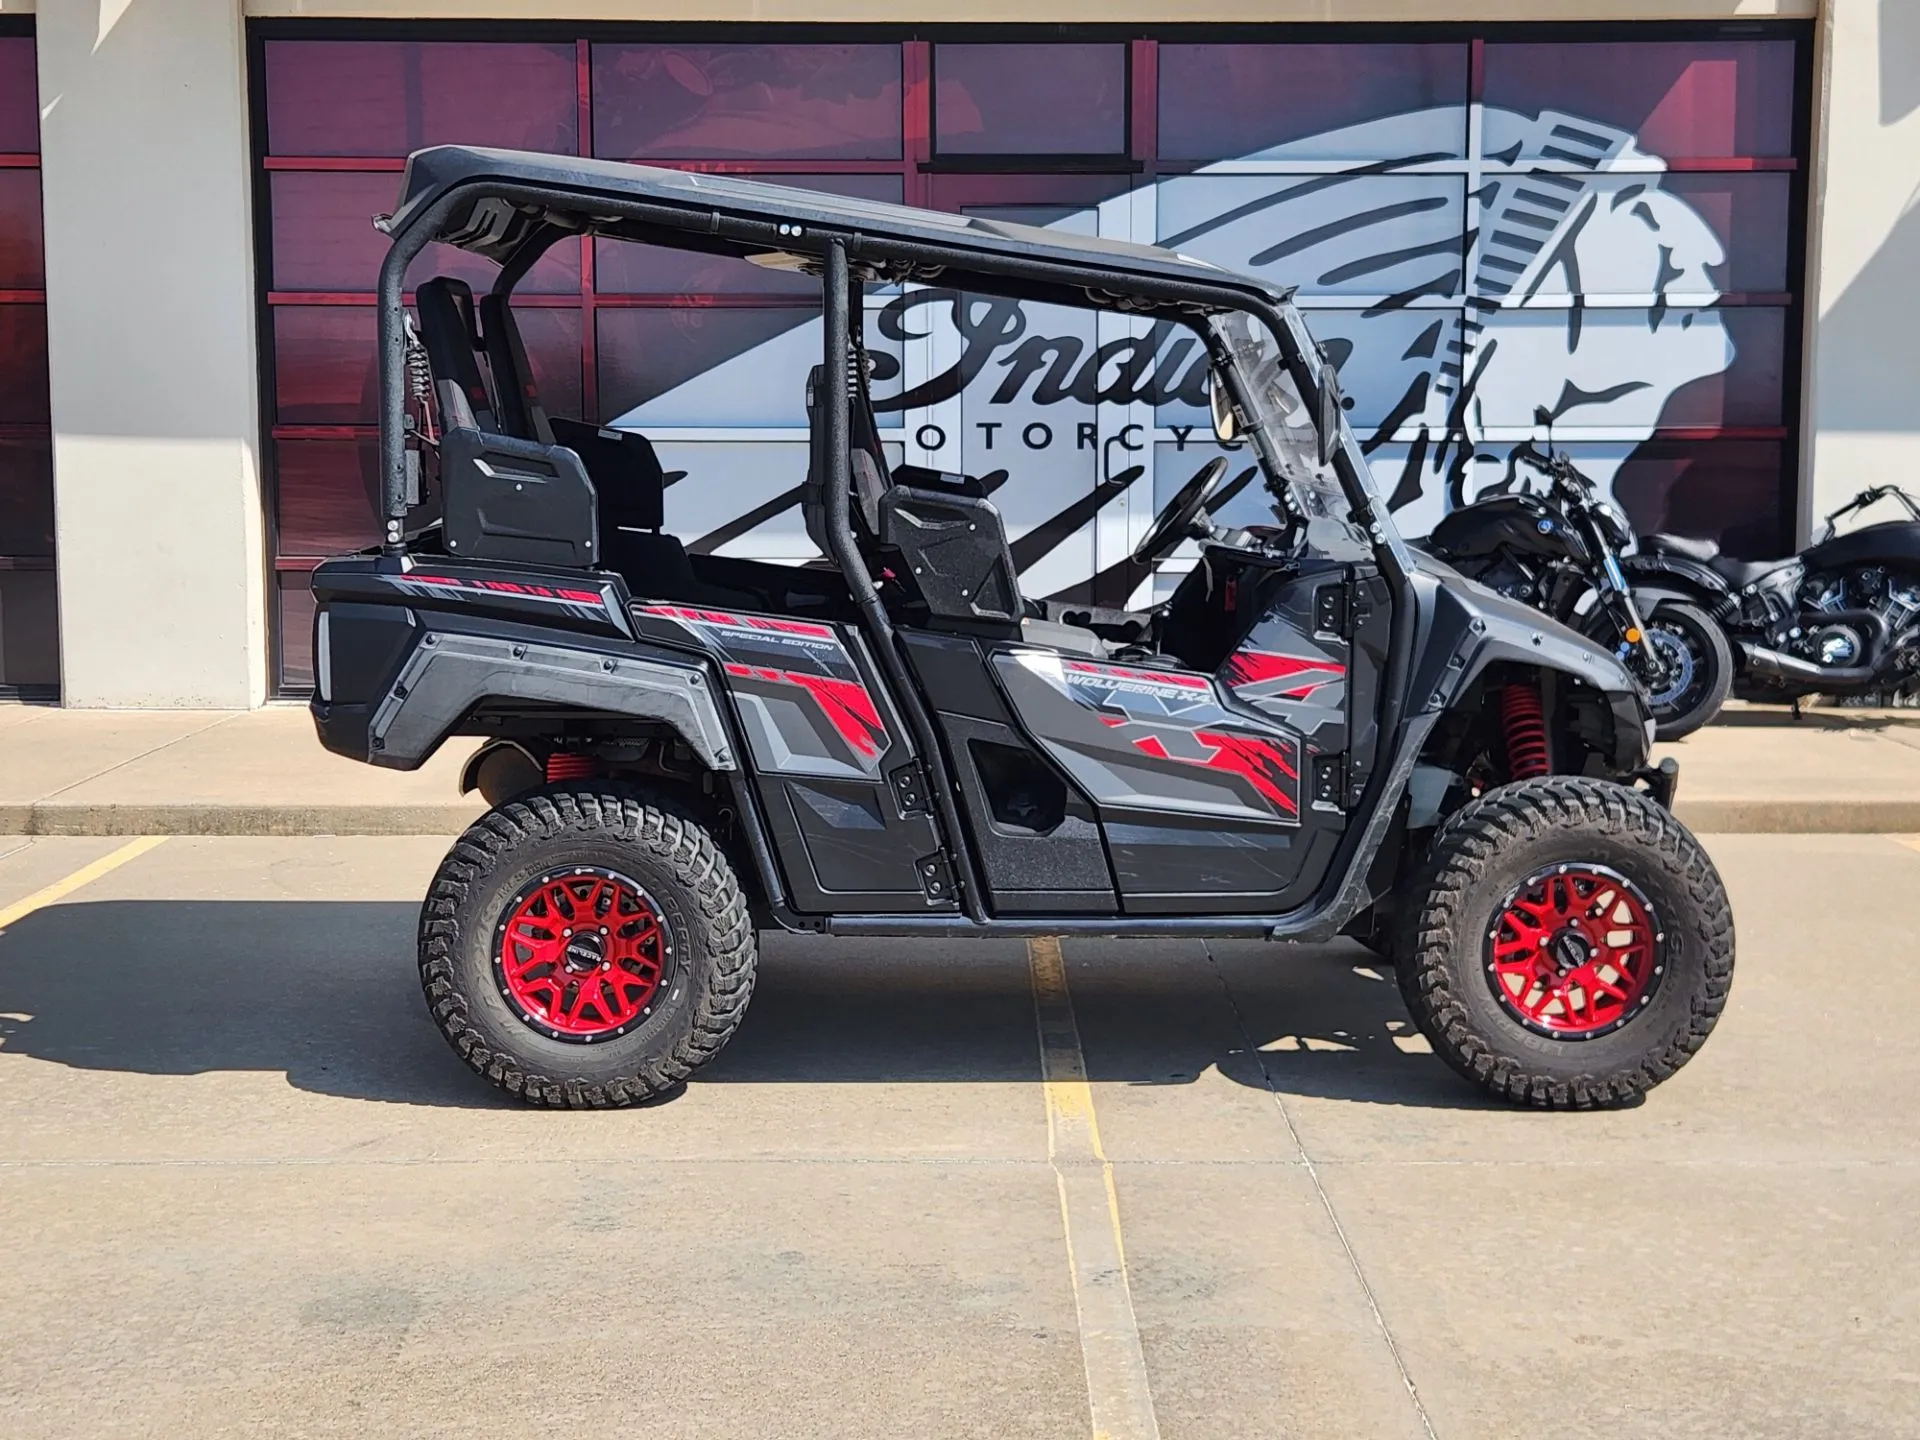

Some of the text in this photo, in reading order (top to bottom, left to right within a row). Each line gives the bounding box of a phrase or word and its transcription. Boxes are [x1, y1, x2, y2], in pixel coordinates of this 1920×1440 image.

[721, 630, 834, 651] SPECIAL EDITION
[1067, 673, 1212, 702] WOLVERINE X4
